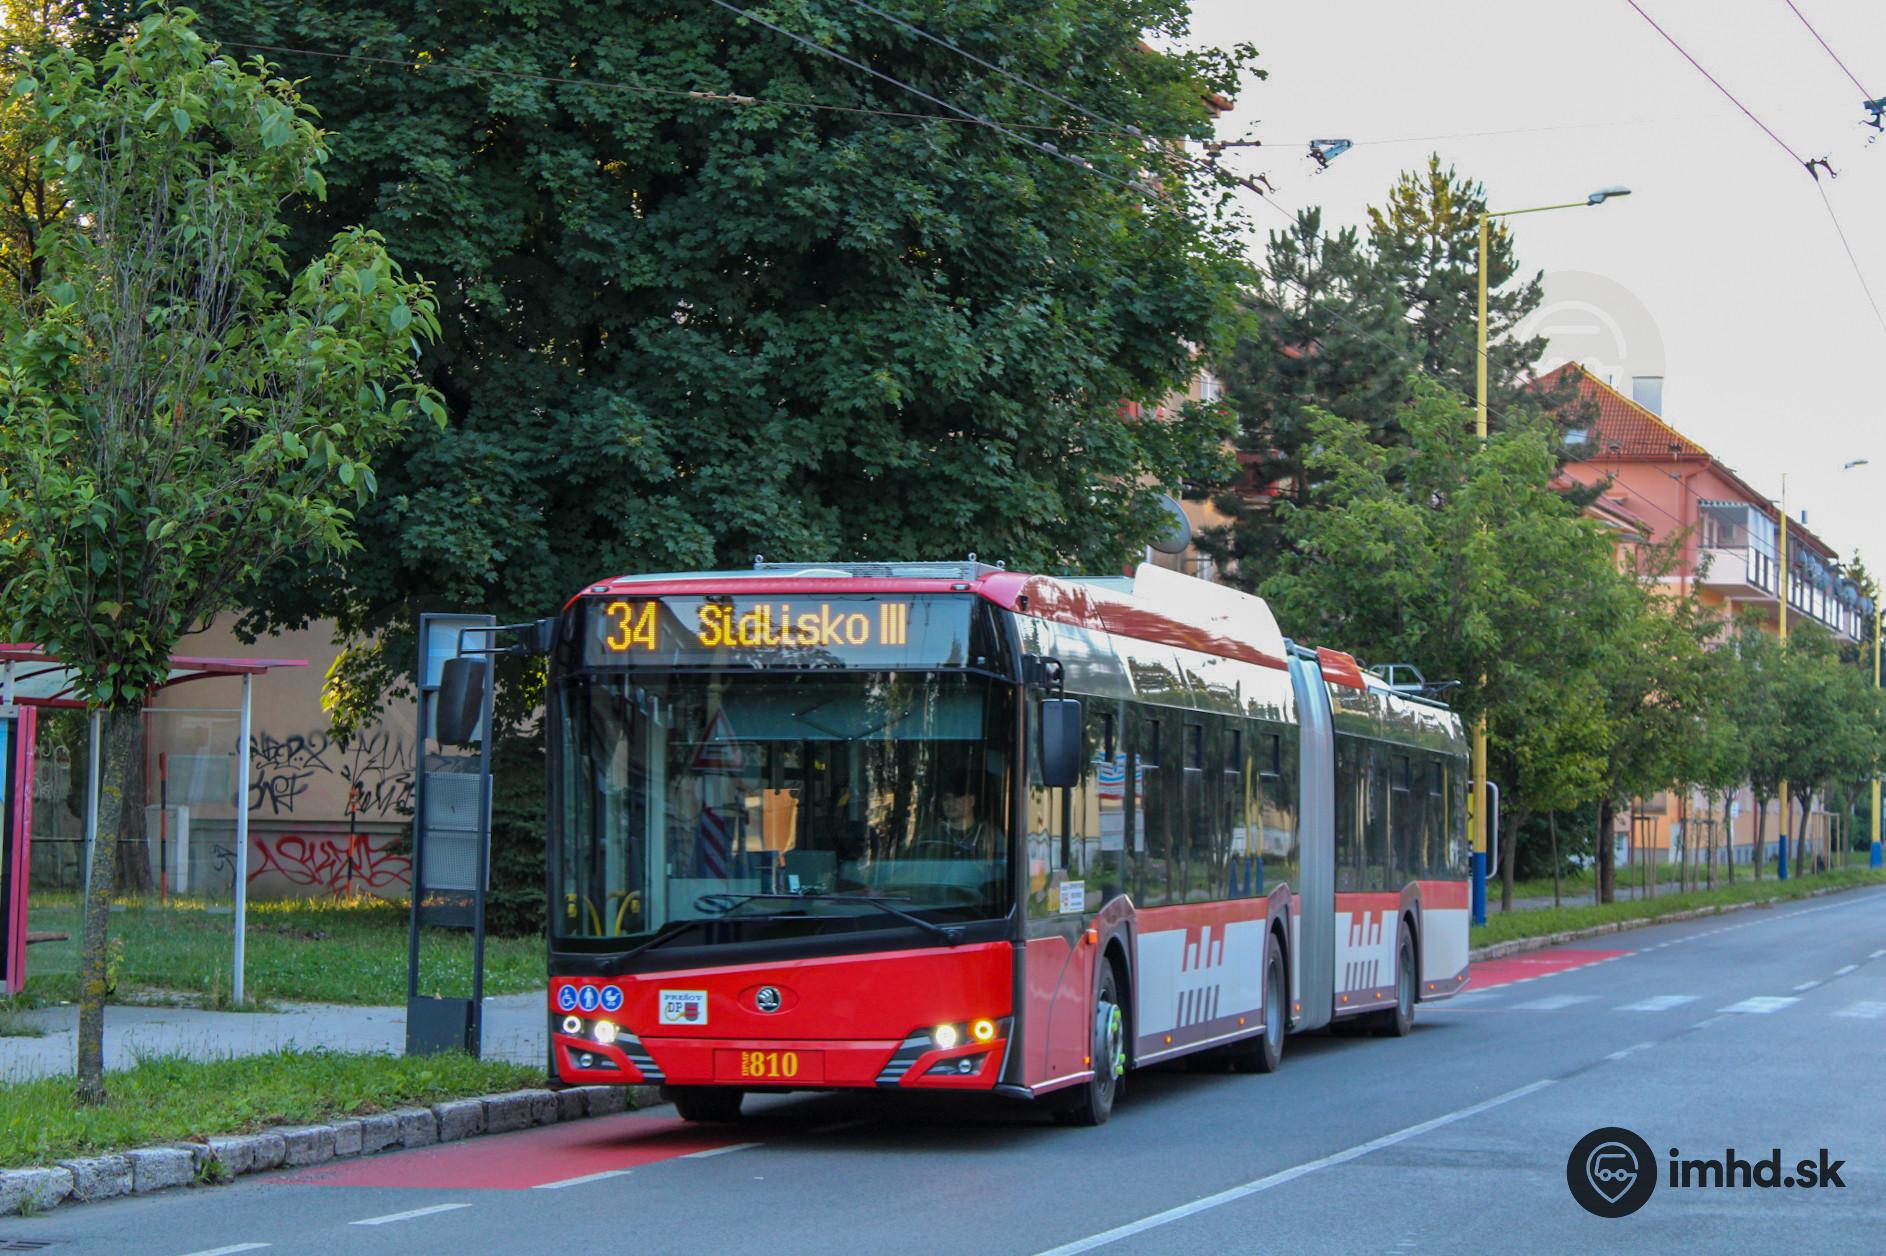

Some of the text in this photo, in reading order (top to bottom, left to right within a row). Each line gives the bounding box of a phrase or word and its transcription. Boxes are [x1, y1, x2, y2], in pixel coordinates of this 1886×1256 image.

[607, 601, 657, 650] 34
[699, 603, 869, 646] Sídlisko
[750, 1051, 798, 1077] 810
